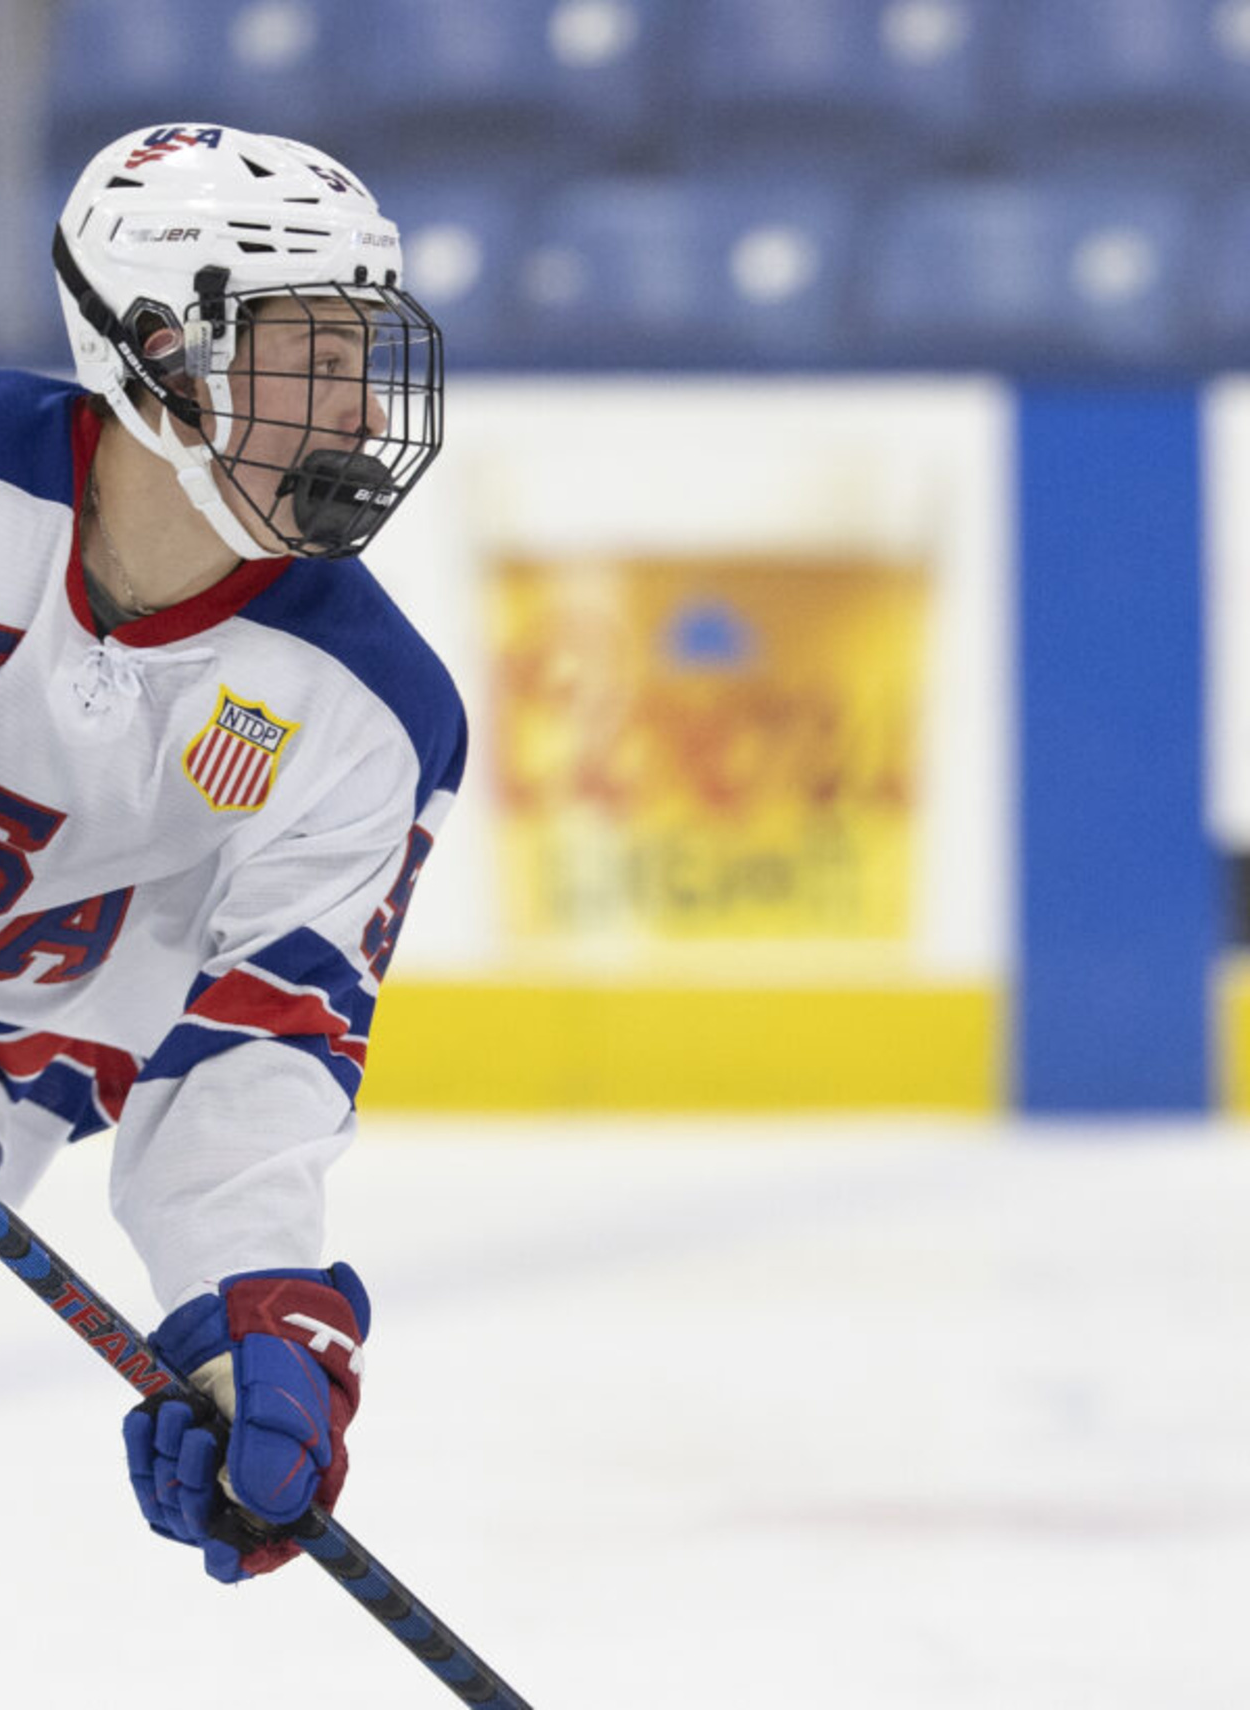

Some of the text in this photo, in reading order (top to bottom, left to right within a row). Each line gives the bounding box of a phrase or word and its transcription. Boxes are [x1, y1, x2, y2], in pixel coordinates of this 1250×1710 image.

[129, 228, 202, 242] UER
[356, 232, 397, 248] AUER
[223, 706, 278, 745] NTDP
[50, 1282, 172, 1398] TEAM
